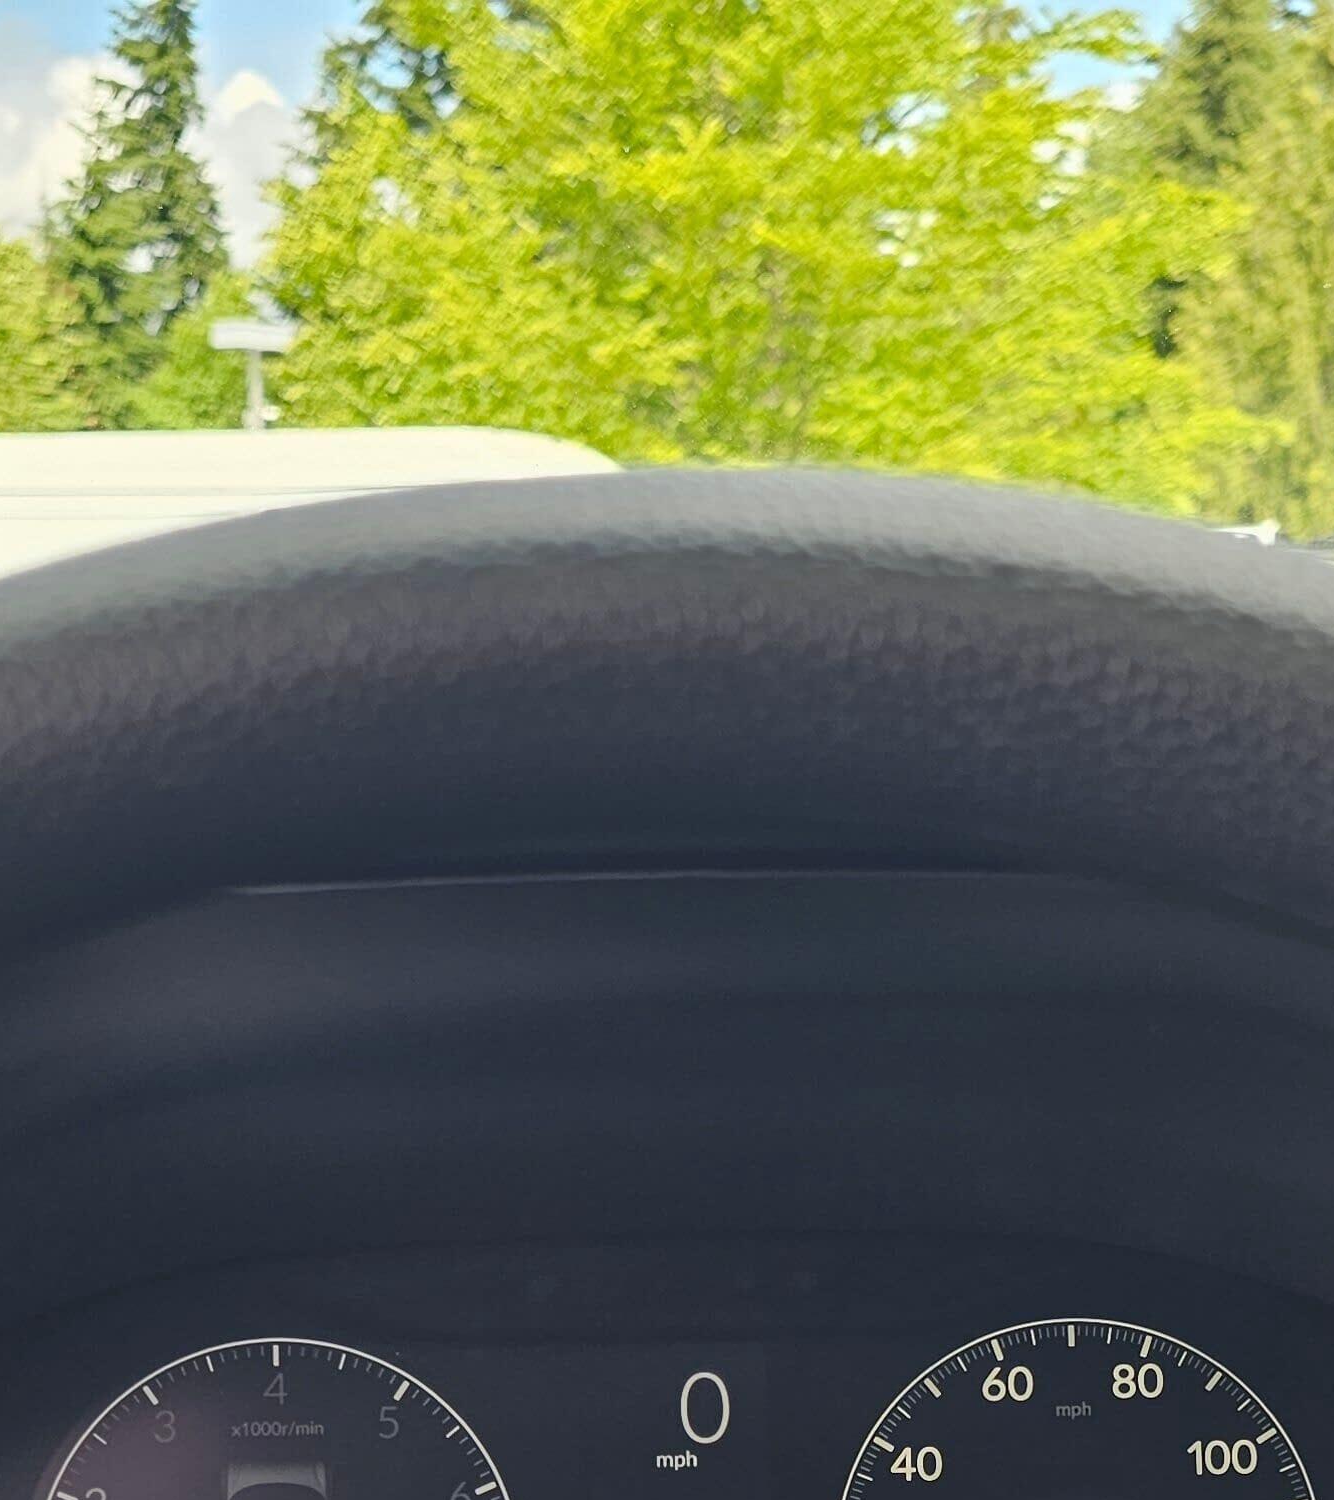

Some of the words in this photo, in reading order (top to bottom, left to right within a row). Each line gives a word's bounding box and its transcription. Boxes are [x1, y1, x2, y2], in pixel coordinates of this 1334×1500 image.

[263, 1373, 288, 1405] 4
[981, 1366, 1034, 1402] 60
[1111, 1363, 1164, 1399] 80
[378, 1405, 400, 1438] 5
[680, 1371, 730, 1445] 0
[1055, 1401, 1092, 1420] mph
[154, 1410, 176, 1443] 3
[231, 1420, 325, 1438] x1000r/min
[656, 1450, 698, 1469] mph
[890, 1446, 943, 1482] 40
[1186, 1439, 1258, 1476] 100
